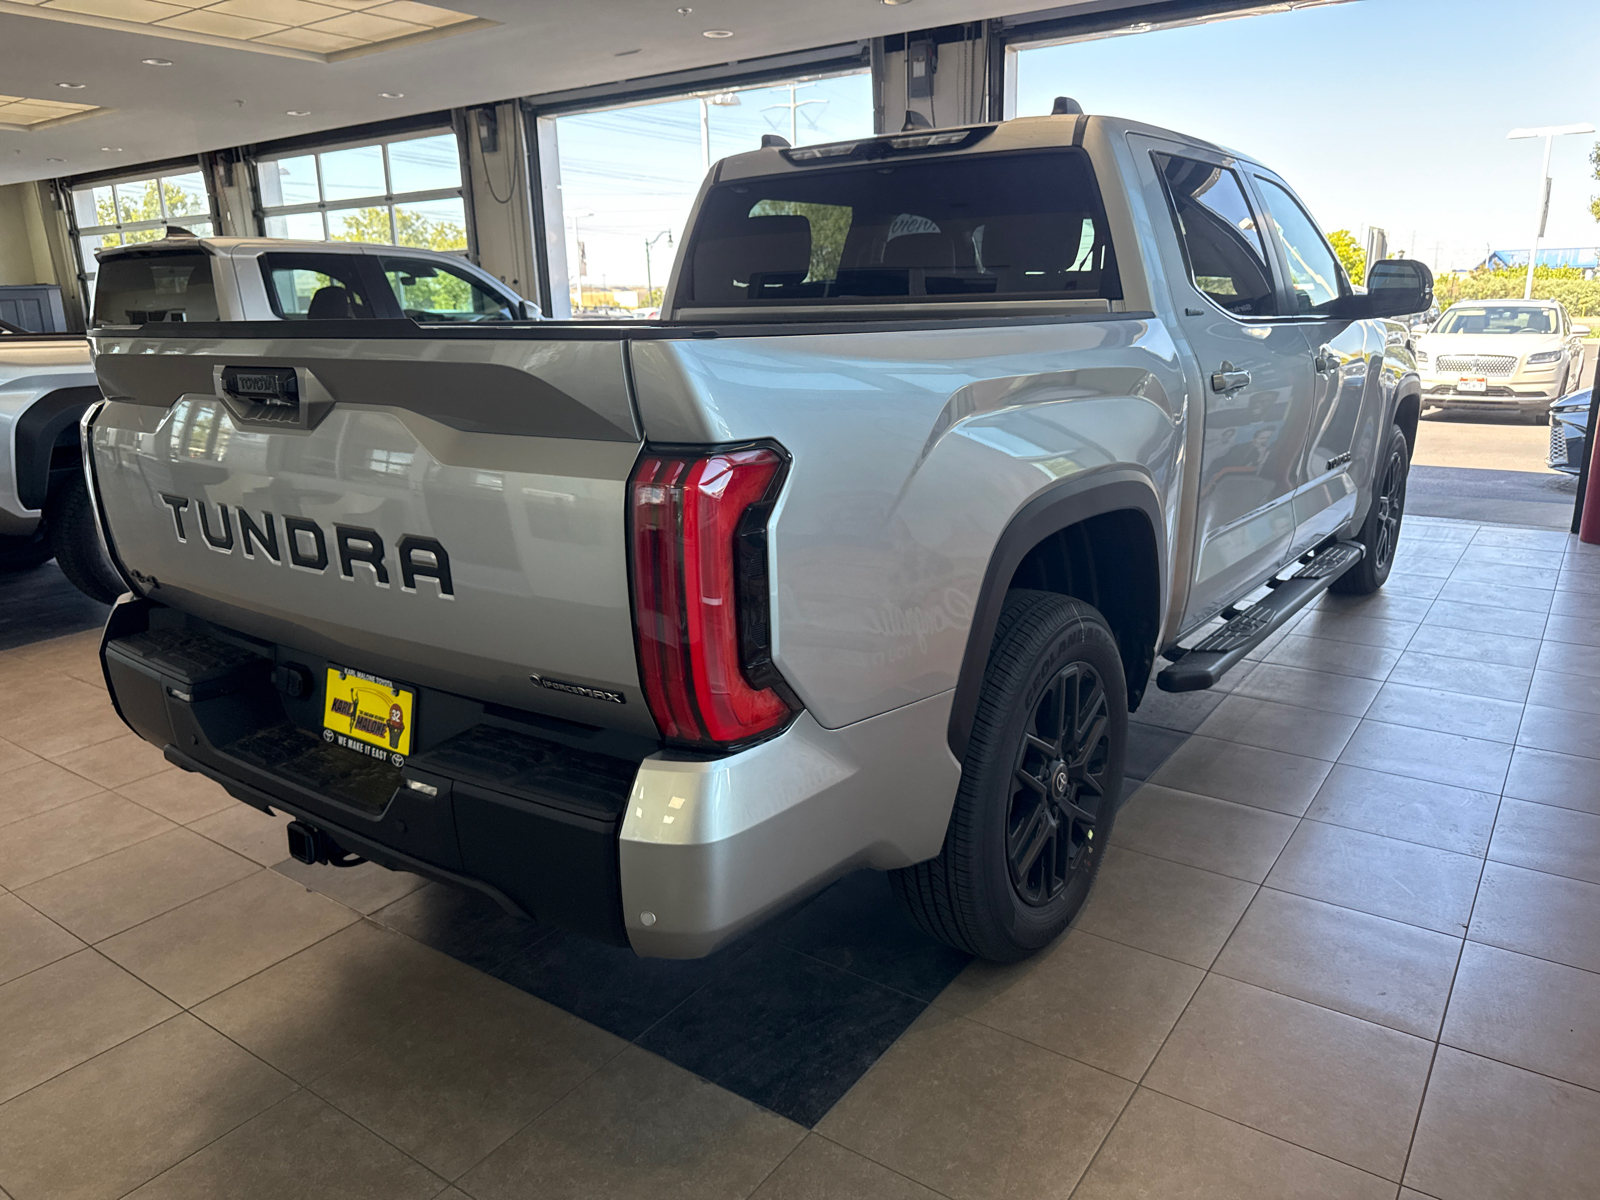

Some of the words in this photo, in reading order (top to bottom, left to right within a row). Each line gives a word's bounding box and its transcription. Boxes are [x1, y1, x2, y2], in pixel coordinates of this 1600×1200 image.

[239, 376, 277, 391] TOYOTA
[159, 491, 454, 600] TUNDRA
[344, 668, 356, 678] KARL
[357, 671, 376, 683] MALONE
[376, 677, 392, 688] TOYOTA
[331, 698, 353, 717] KARL
[392, 709, 401, 723] 32
[355, 716, 386, 738] MALONE
[337, 735, 347, 747] WE
[347, 739, 363, 753] MAKE
[364, 746, 371, 756] IT
[371, 749, 387, 761] EASY
